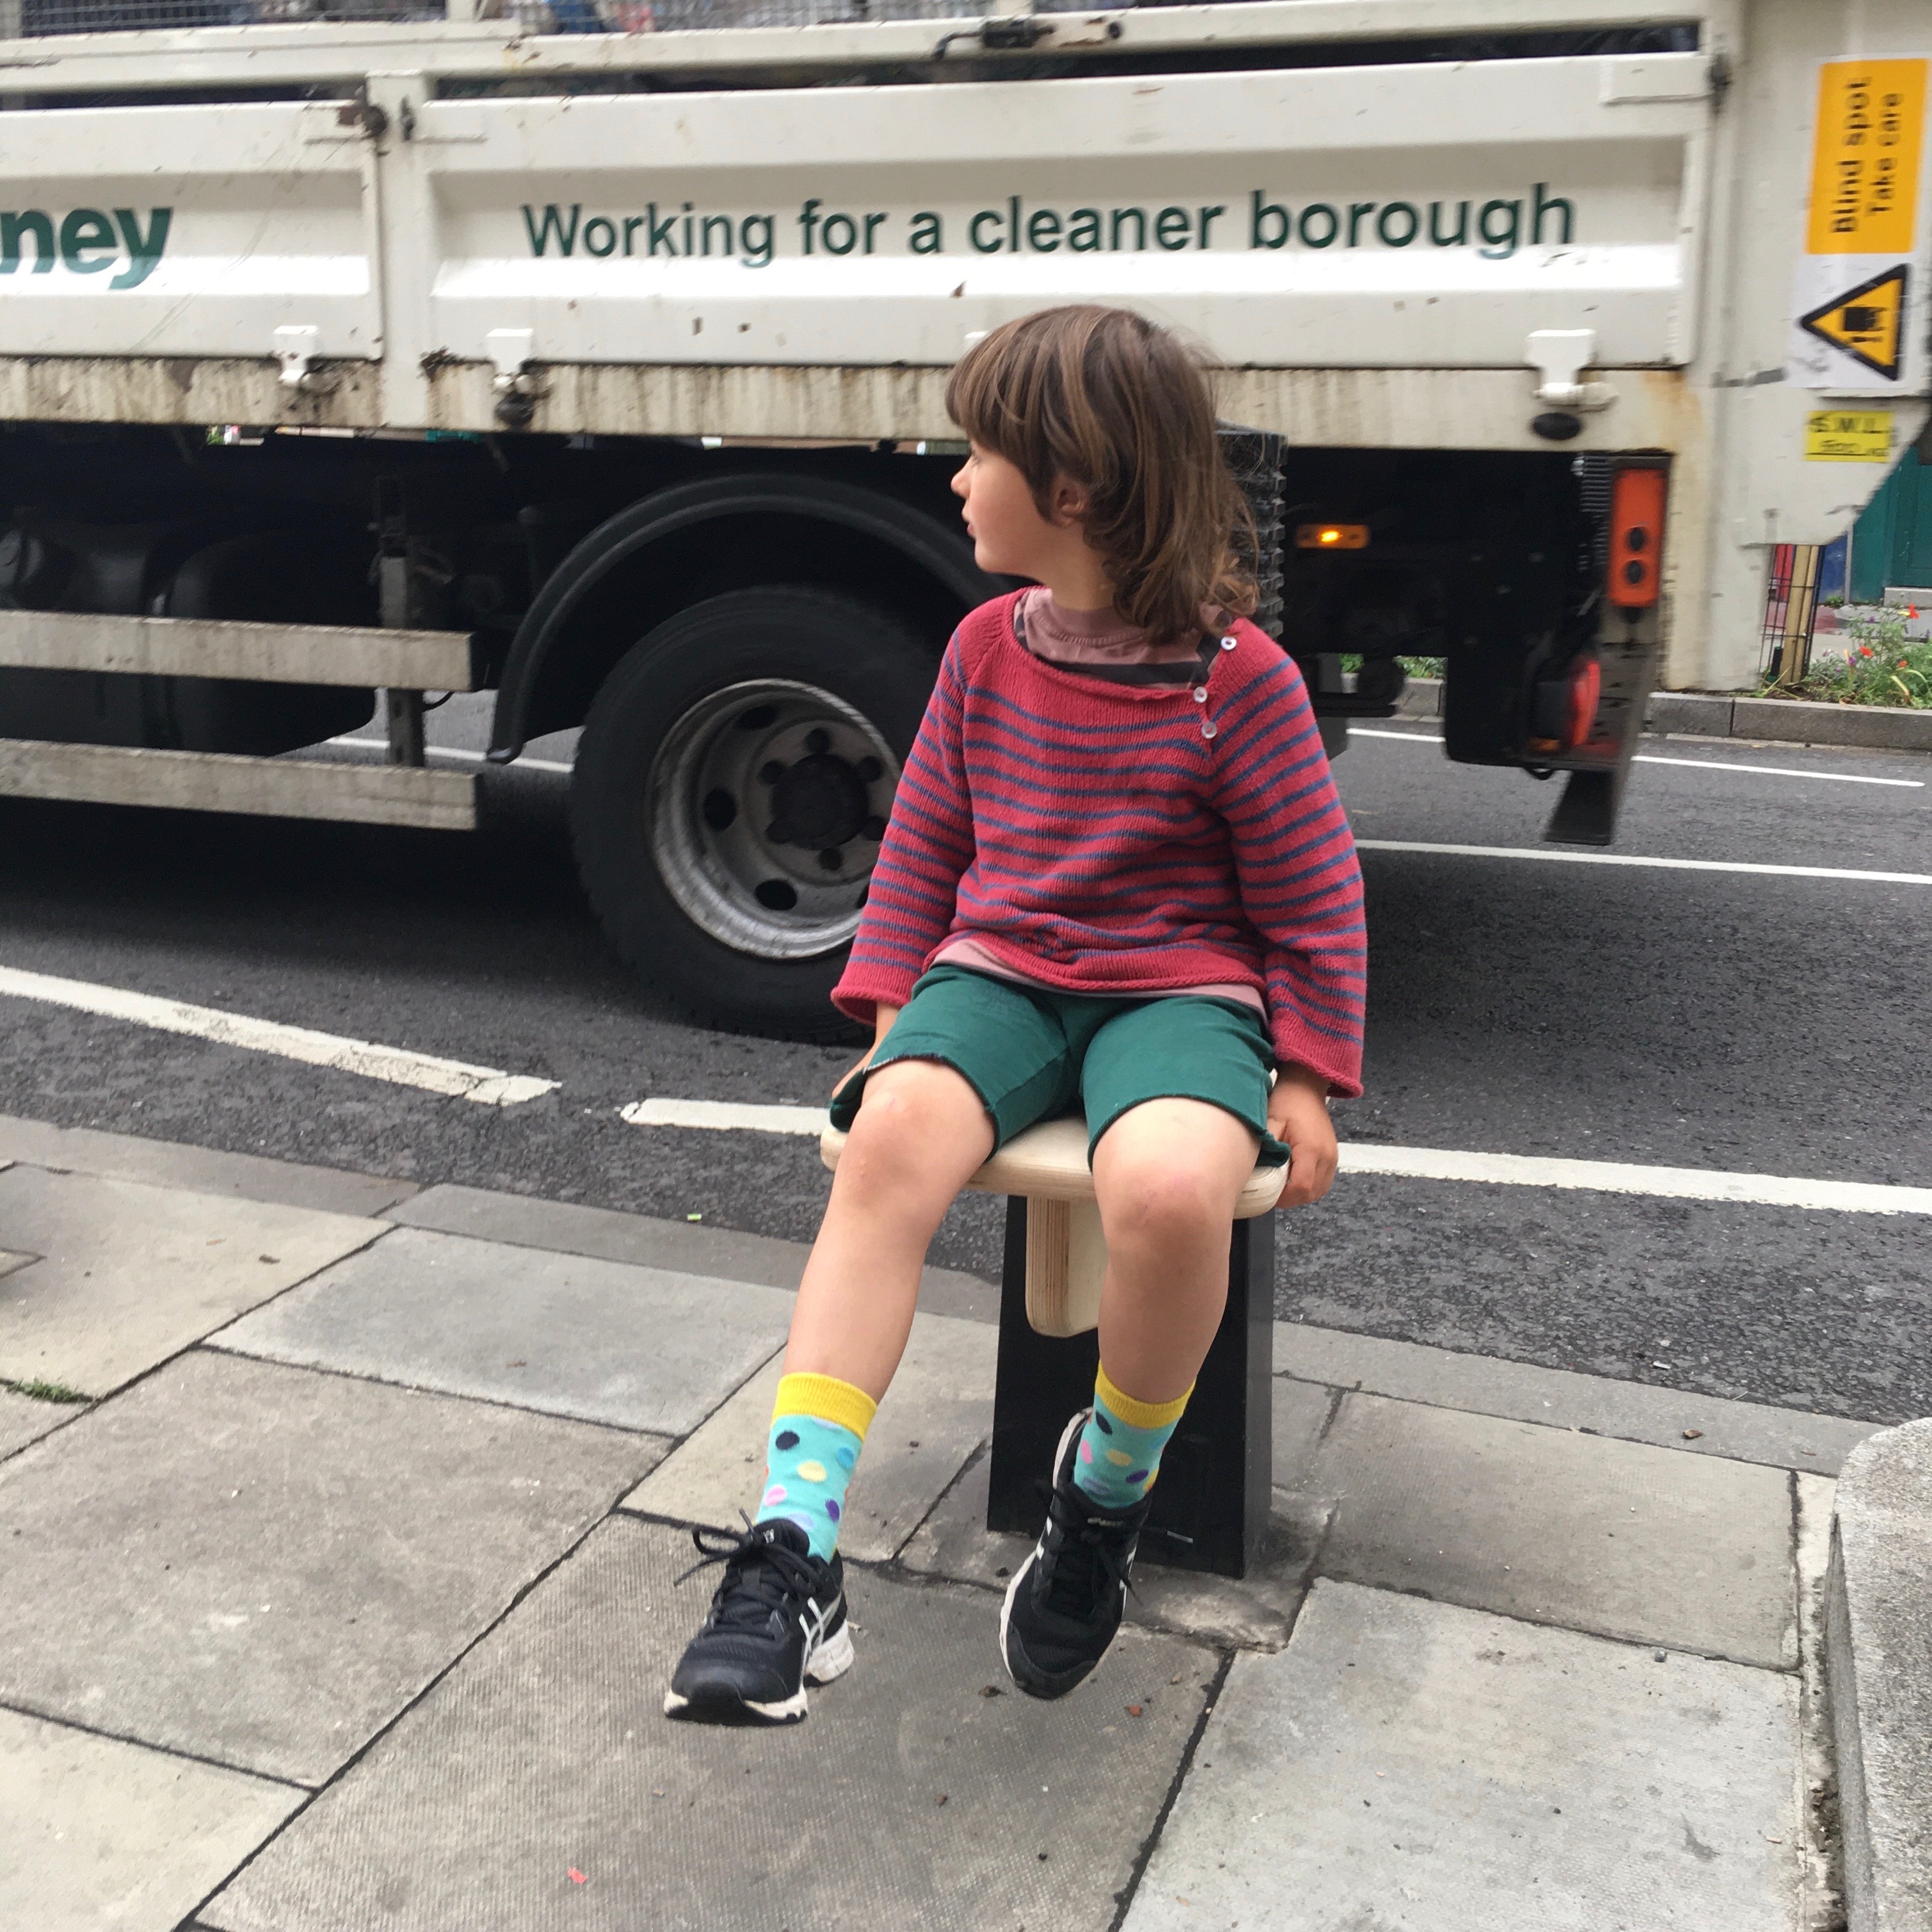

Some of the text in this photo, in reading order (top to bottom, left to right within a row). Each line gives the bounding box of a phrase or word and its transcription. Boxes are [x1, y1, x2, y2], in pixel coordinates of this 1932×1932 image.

[0, 207, 173, 291] ney
[522, 182, 1577, 268] Working for a cleaner borough
